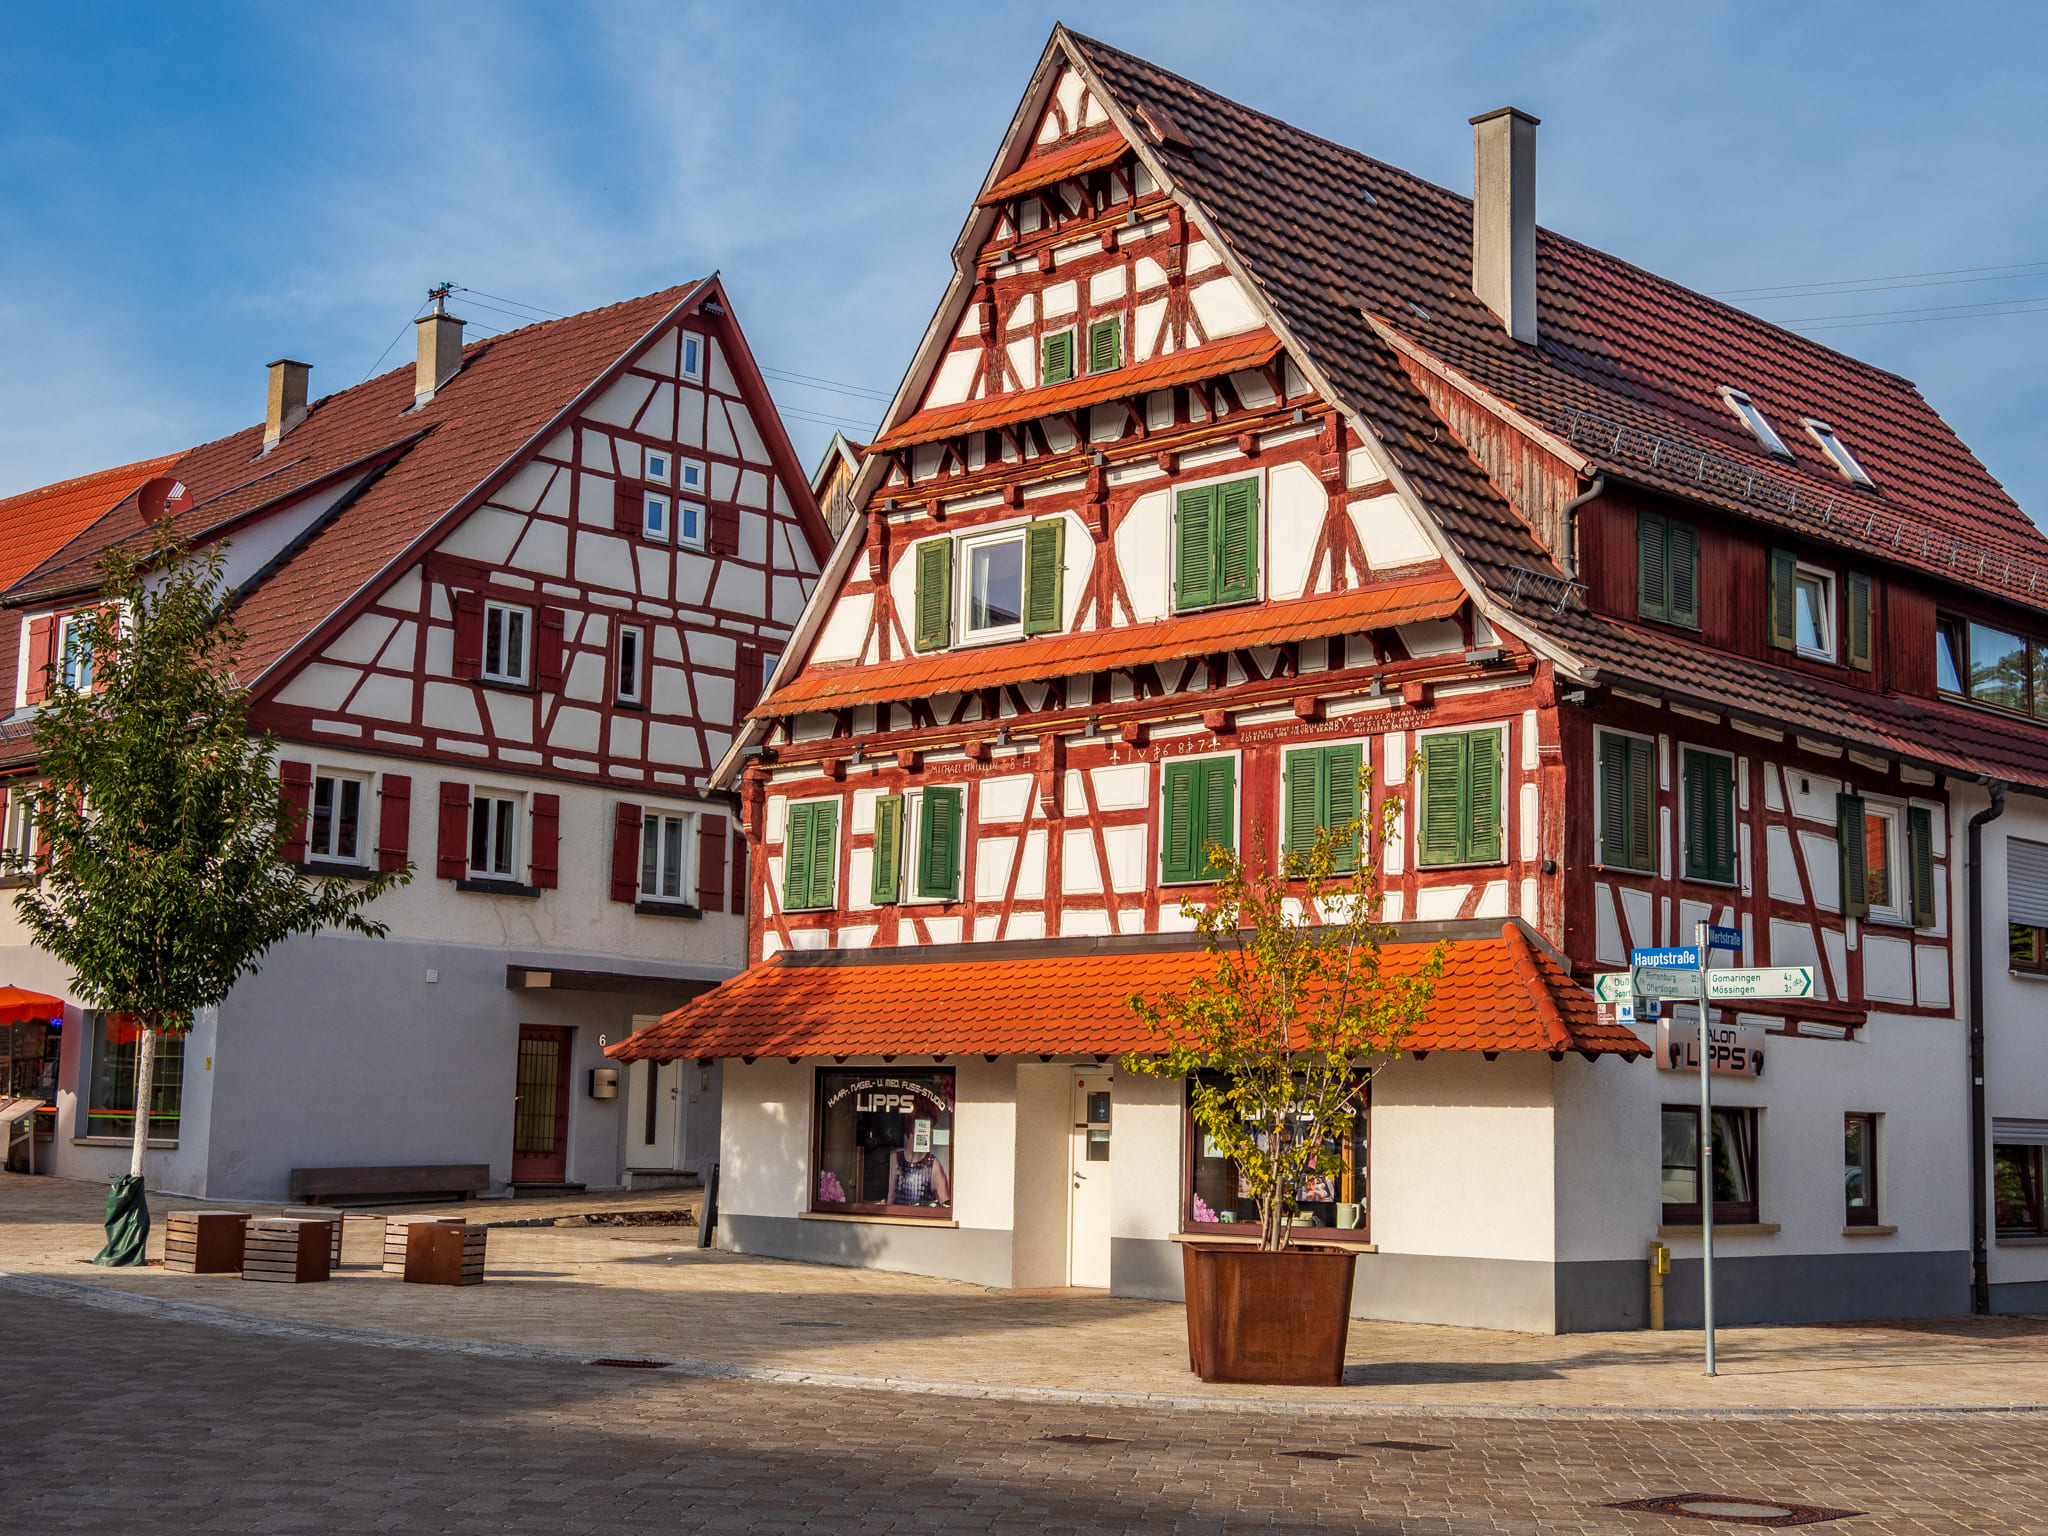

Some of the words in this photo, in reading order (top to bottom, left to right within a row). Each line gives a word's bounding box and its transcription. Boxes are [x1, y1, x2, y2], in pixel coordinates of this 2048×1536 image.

[1634, 950, 1696, 967] Hauptstraße
[1712, 974, 1761, 984] Gomaringen
[1712, 985, 1755, 995] Mössingen
[599, 1034, 606, 1047] 6
[856, 1093, 915, 1113] LIPPS
